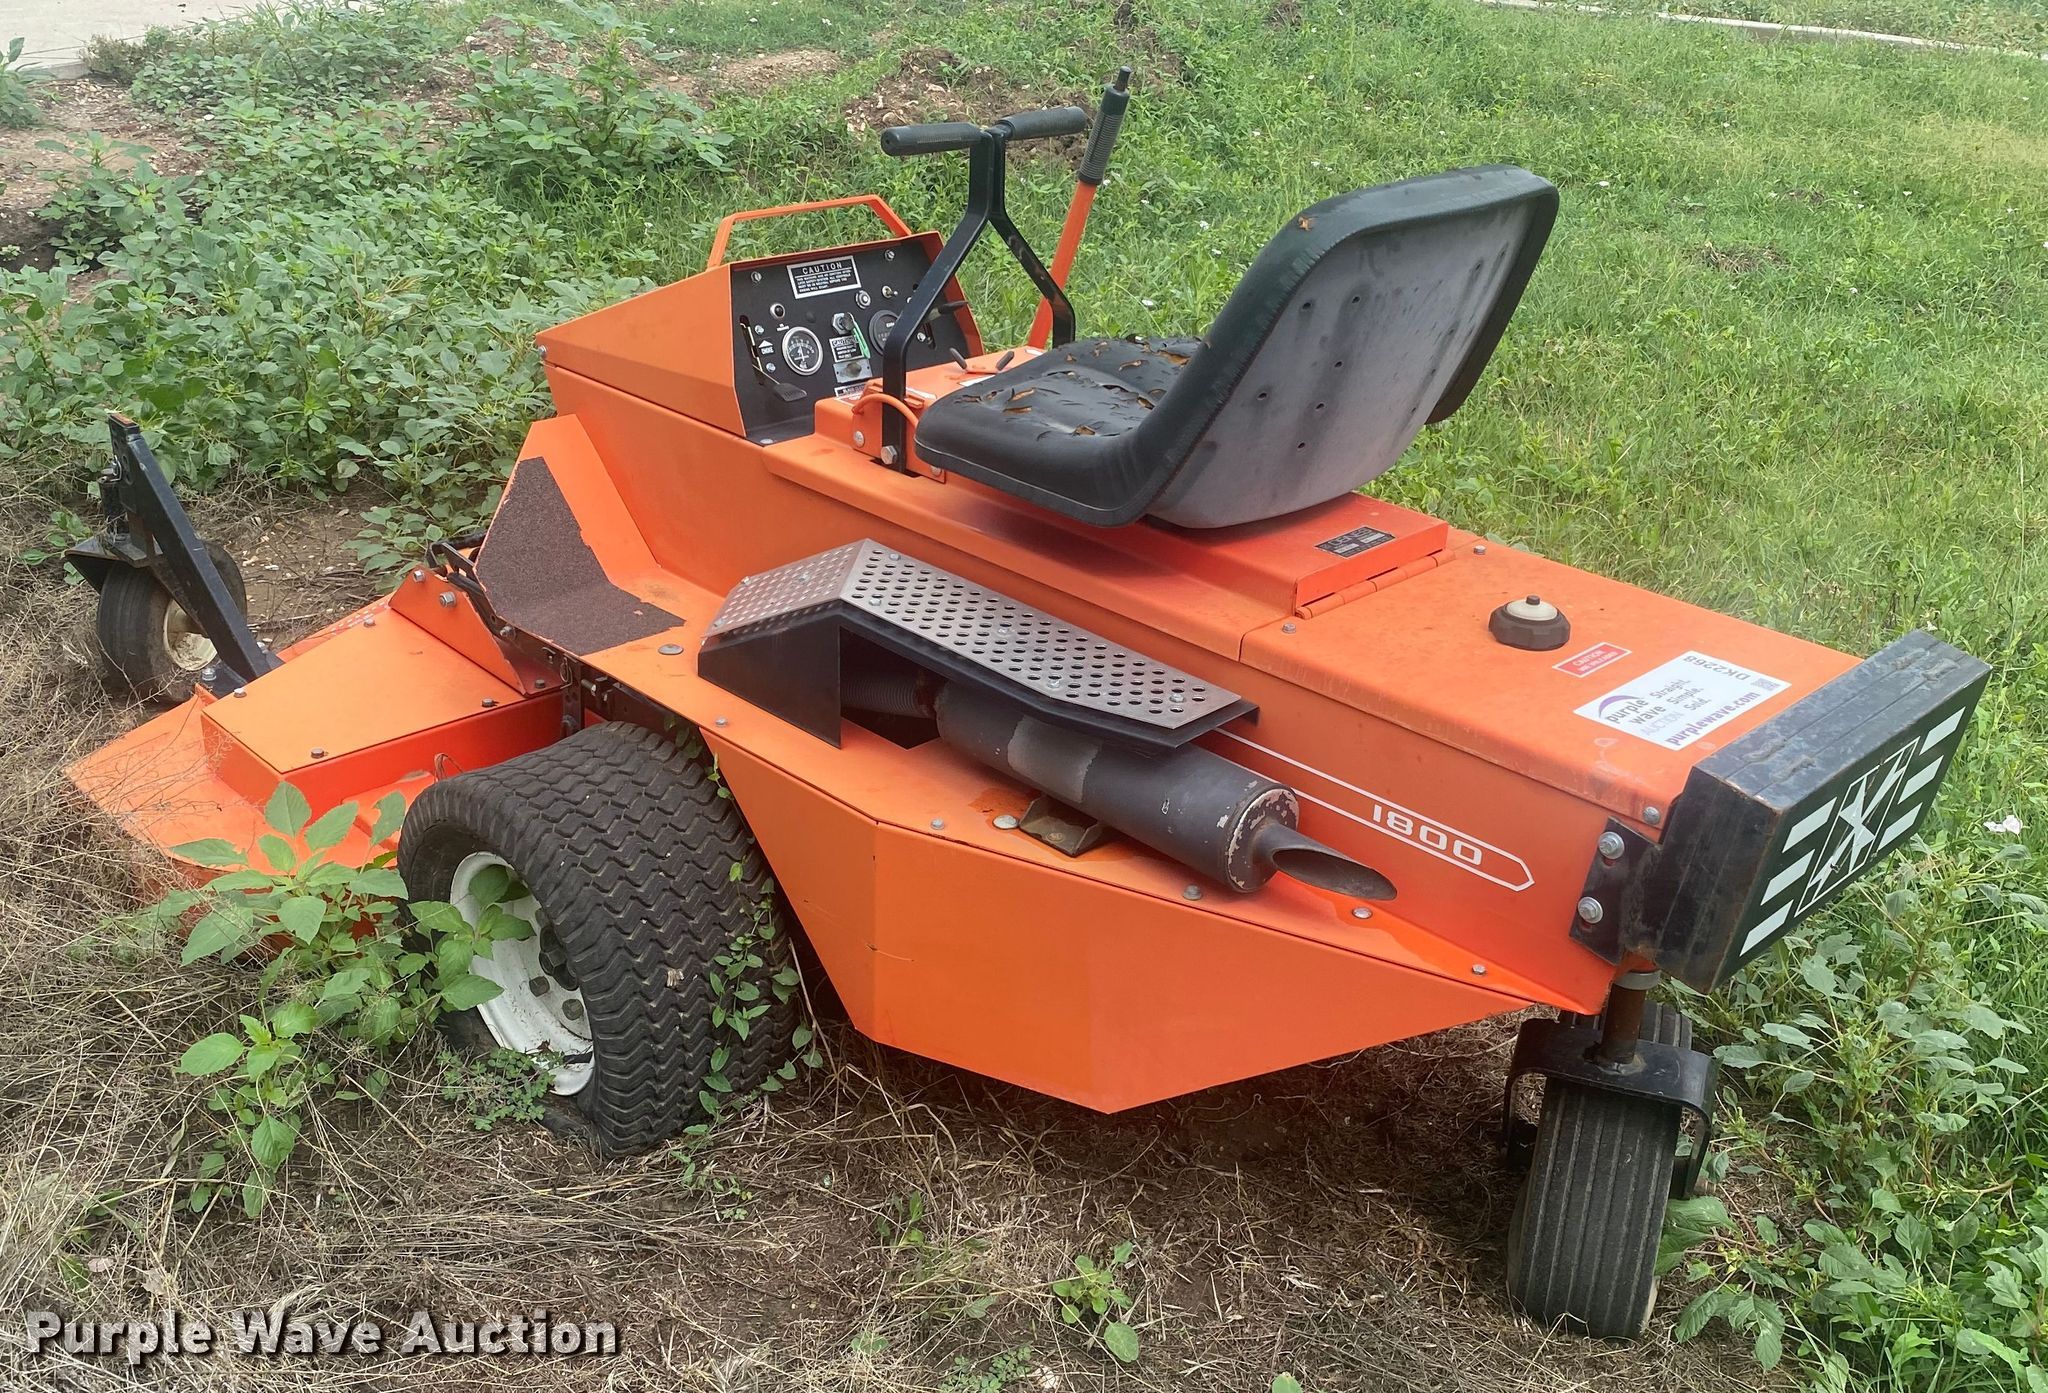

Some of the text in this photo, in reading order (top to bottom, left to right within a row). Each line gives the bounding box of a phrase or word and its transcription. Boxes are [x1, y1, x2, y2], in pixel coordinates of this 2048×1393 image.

[802, 262, 842, 275] CAUTION
[1683, 655, 1751, 681] DK2268
[1649, 679, 1691, 699] Straight.
[1665, 688, 1704, 704] Simple.
[1605, 698, 1649, 724] purple
[1628, 705, 1667, 724] wave
[1682, 697, 1712, 711] Sold.
[1640, 711, 1685, 736] AUCTION
[1665, 691, 1760, 746] purplewave.com
[1372, 804, 1483, 866] 1800
